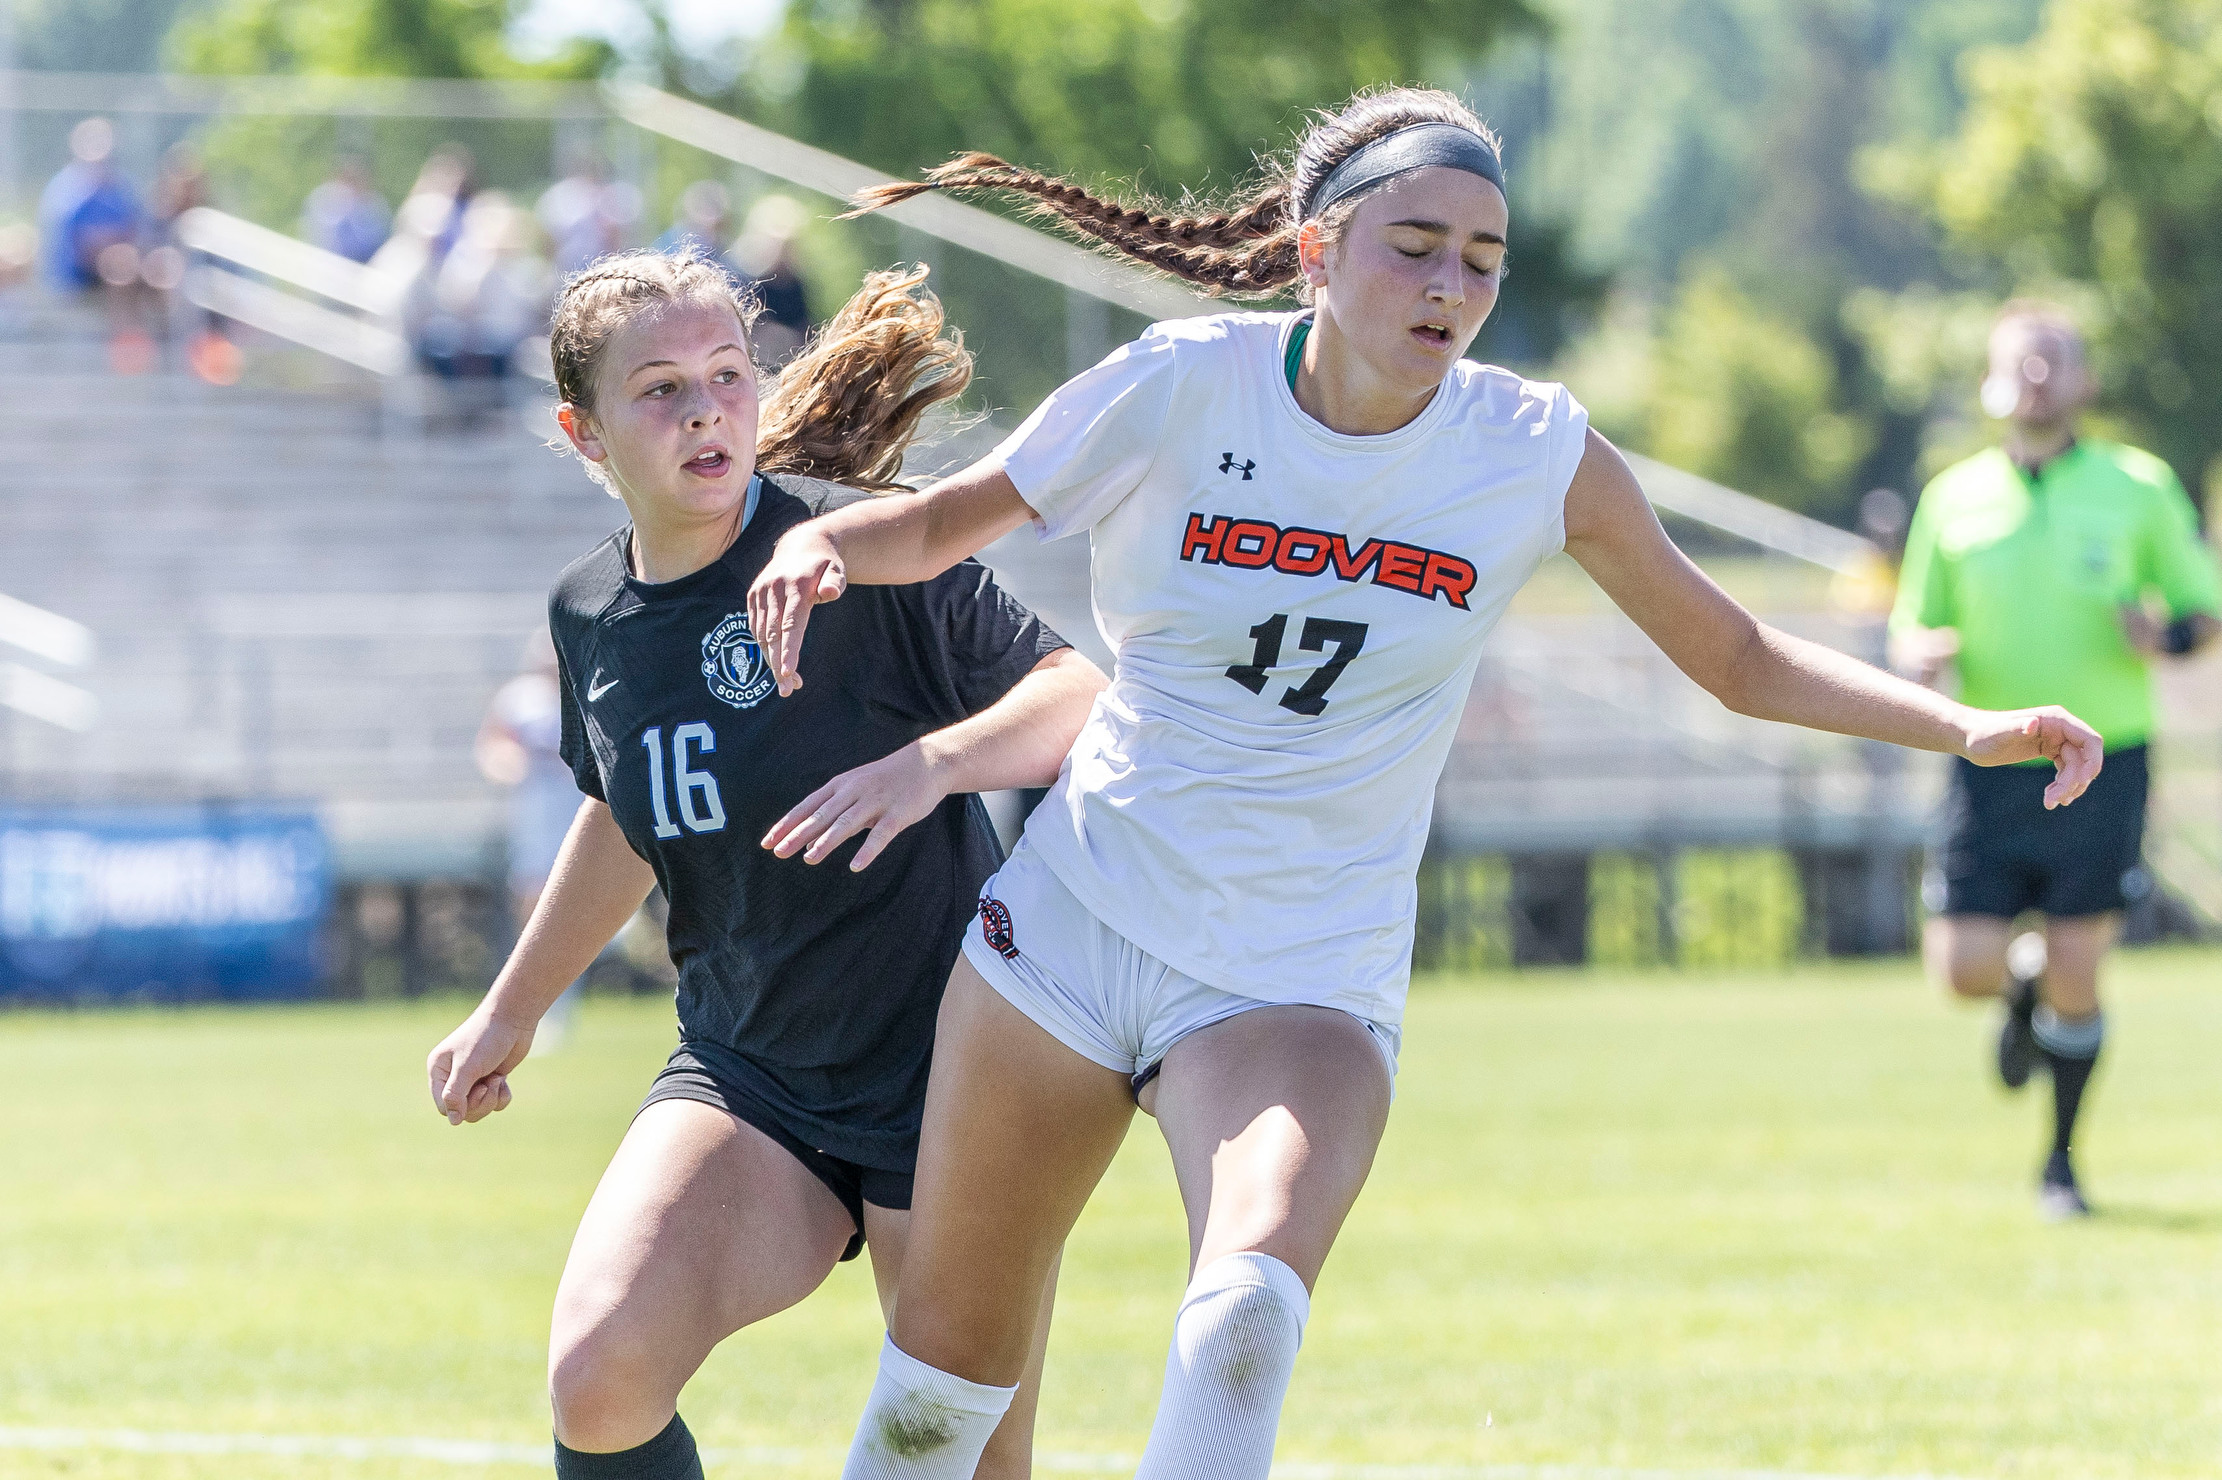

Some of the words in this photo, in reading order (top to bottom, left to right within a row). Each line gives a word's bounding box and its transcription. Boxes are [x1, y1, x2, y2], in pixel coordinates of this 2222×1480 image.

[1179, 512, 1478, 612] HOOVER
[708, 620, 747, 656] AUBURN
[1224, 613, 1370, 717] 17
[716, 679, 771, 701] SOCCER
[641, 720, 728, 840] 16
